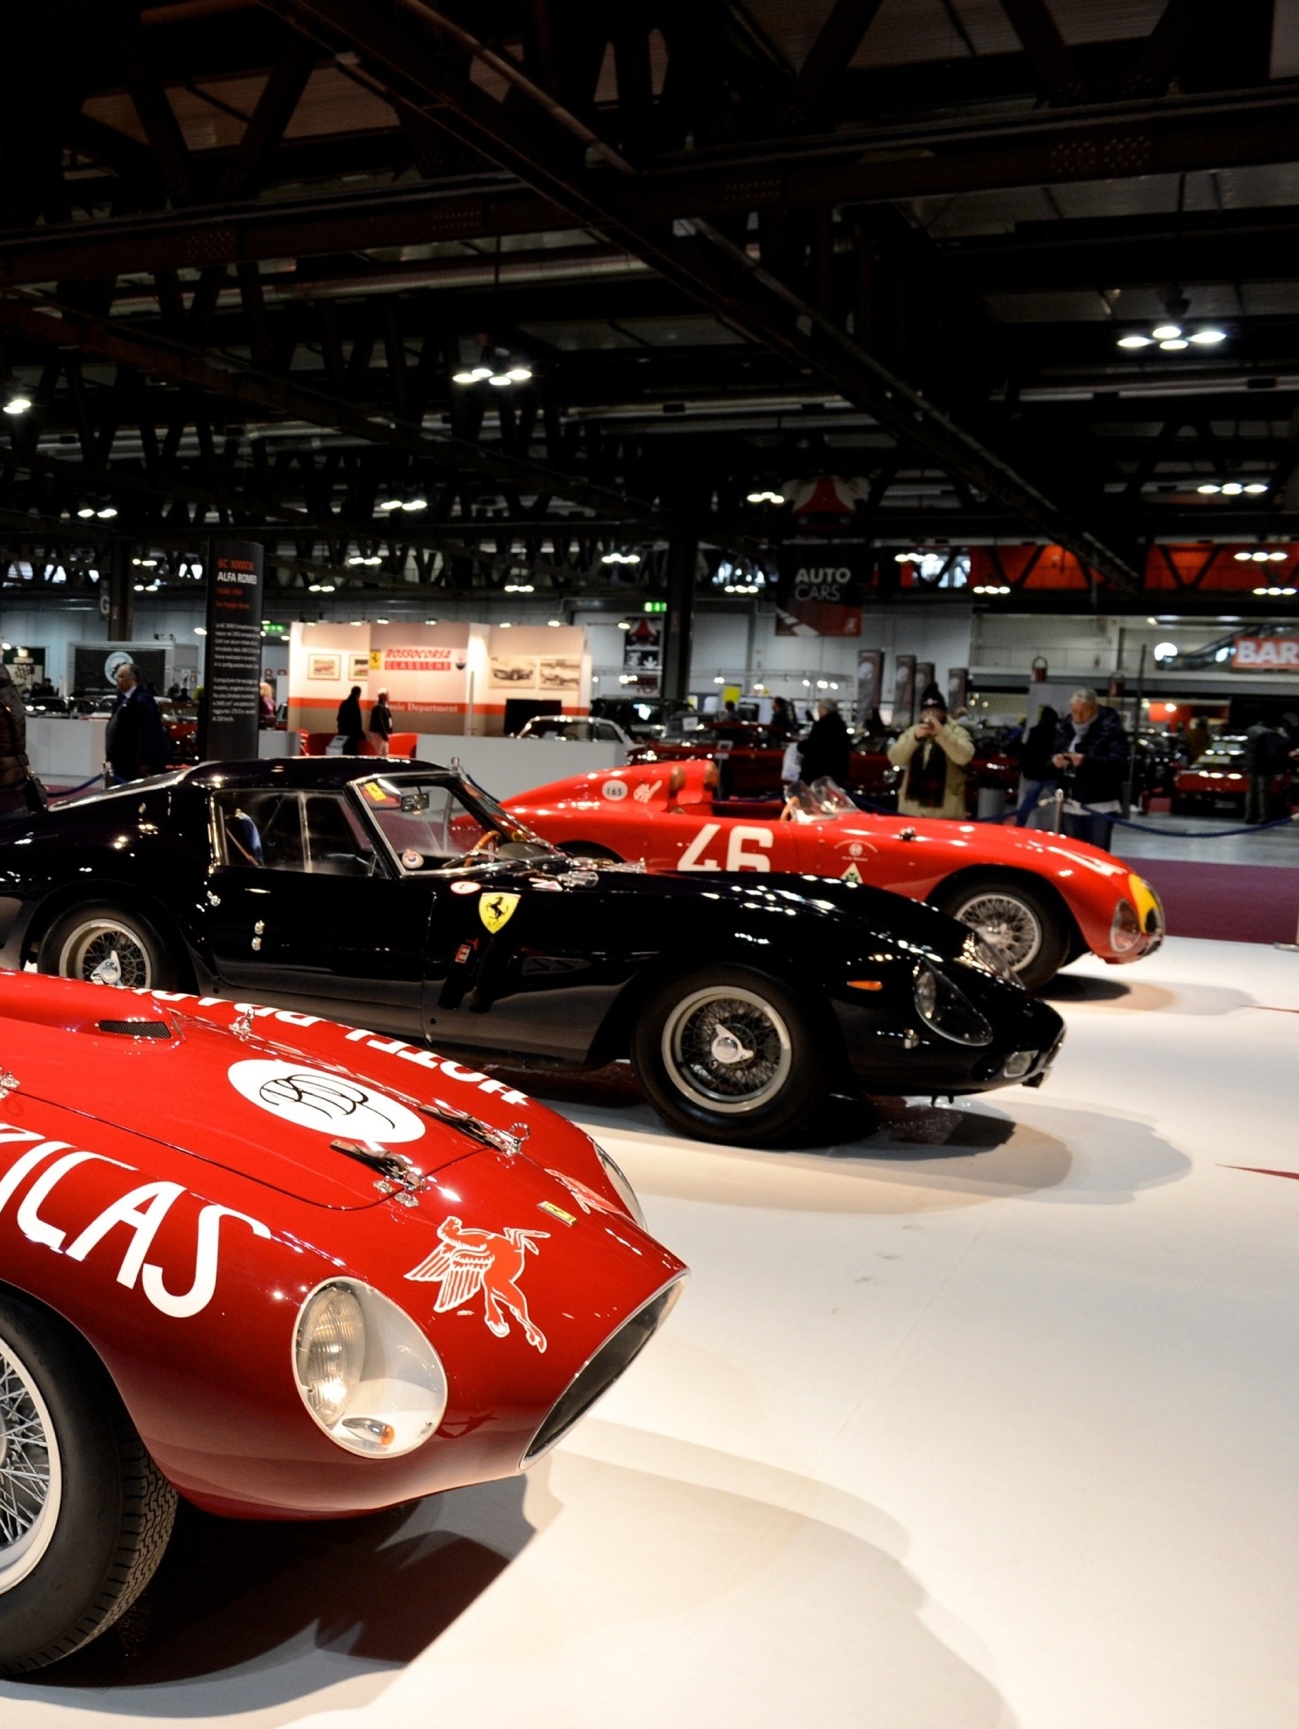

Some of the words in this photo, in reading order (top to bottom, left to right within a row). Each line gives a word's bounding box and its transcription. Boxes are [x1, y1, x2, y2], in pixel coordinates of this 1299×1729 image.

[217, 571, 237, 583] ALFA
[795, 567, 851, 584] AUTO
[795, 585, 841, 602] CARS
[101, 596, 110, 614] G
[677, 824, 773, 872] 46
